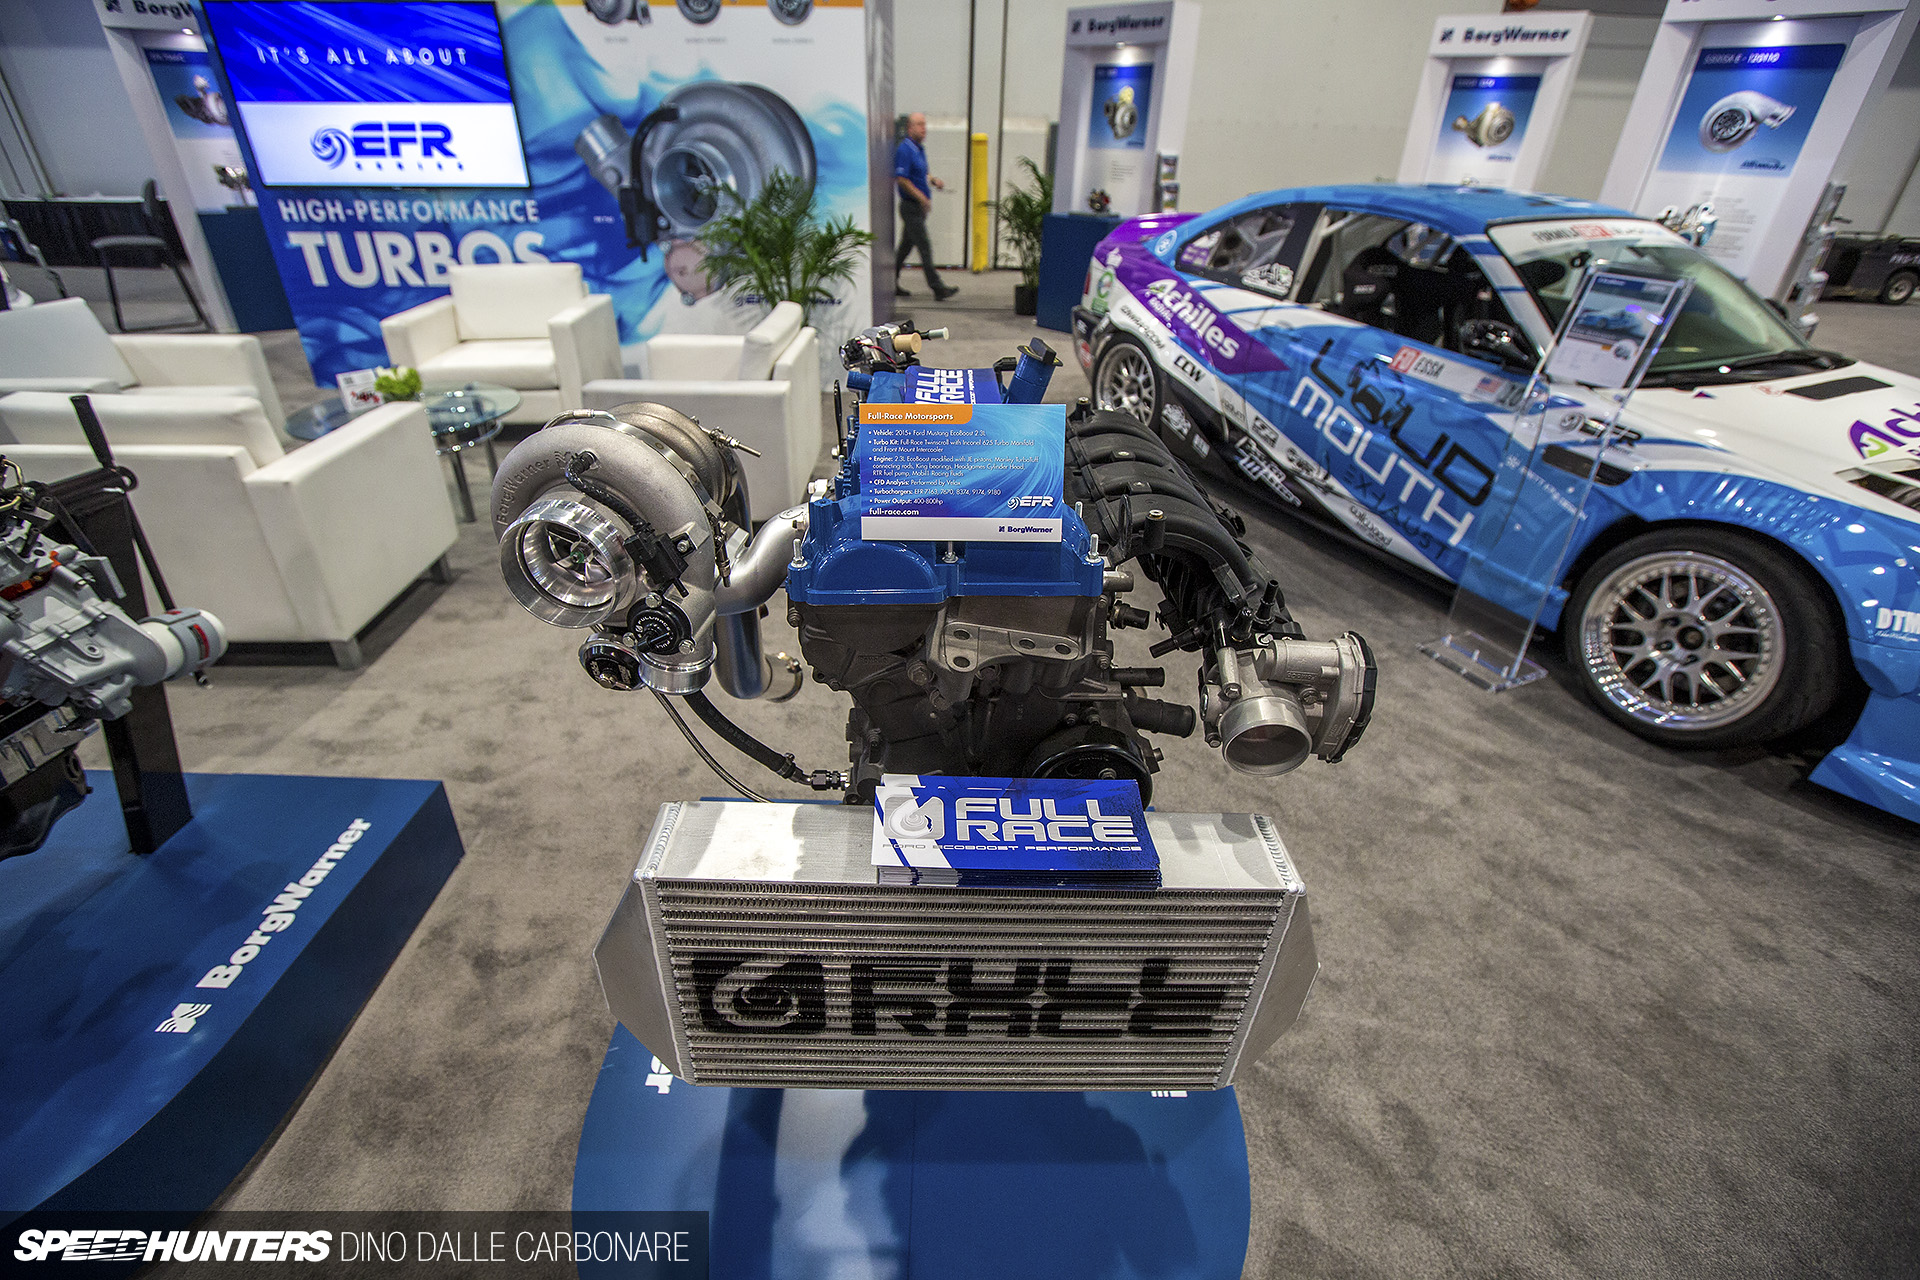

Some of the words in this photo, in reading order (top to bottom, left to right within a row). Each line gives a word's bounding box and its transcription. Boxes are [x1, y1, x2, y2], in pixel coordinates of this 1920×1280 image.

[1087, 16, 1164, 35] BorgWarner
[1464, 26, 1570, 44] BorgWarner
[257, 46, 309, 64] IT'S
[327, 47, 369, 64] ALL
[386, 47, 467, 65] ABOUT
[351, 121, 457, 158] EFR
[278, 199, 540, 222] HIGH-PERFORMANCE
[285, 230, 551, 287] TURBOS
[1148, 278, 1240, 360] Achilles
[1174, 355, 1206, 382] CCW
[1414, 357, 1445, 378] ESSA
[868, 412, 903, 420] Full-Race
[905, 412, 954, 421] Motorsports
[1290, 376, 1475, 546] MOUTH
[496, 459, 552, 526] BorgWarner
[1019, 496, 1054, 507] EFR
[869, 508, 920, 516] full-race.com
[1008, 525, 1053, 534] BorgWarner
[955, 797, 1133, 821] FULL
[956, 819, 1139, 843] RACE
[195, 818, 372, 989] BorgWarner
